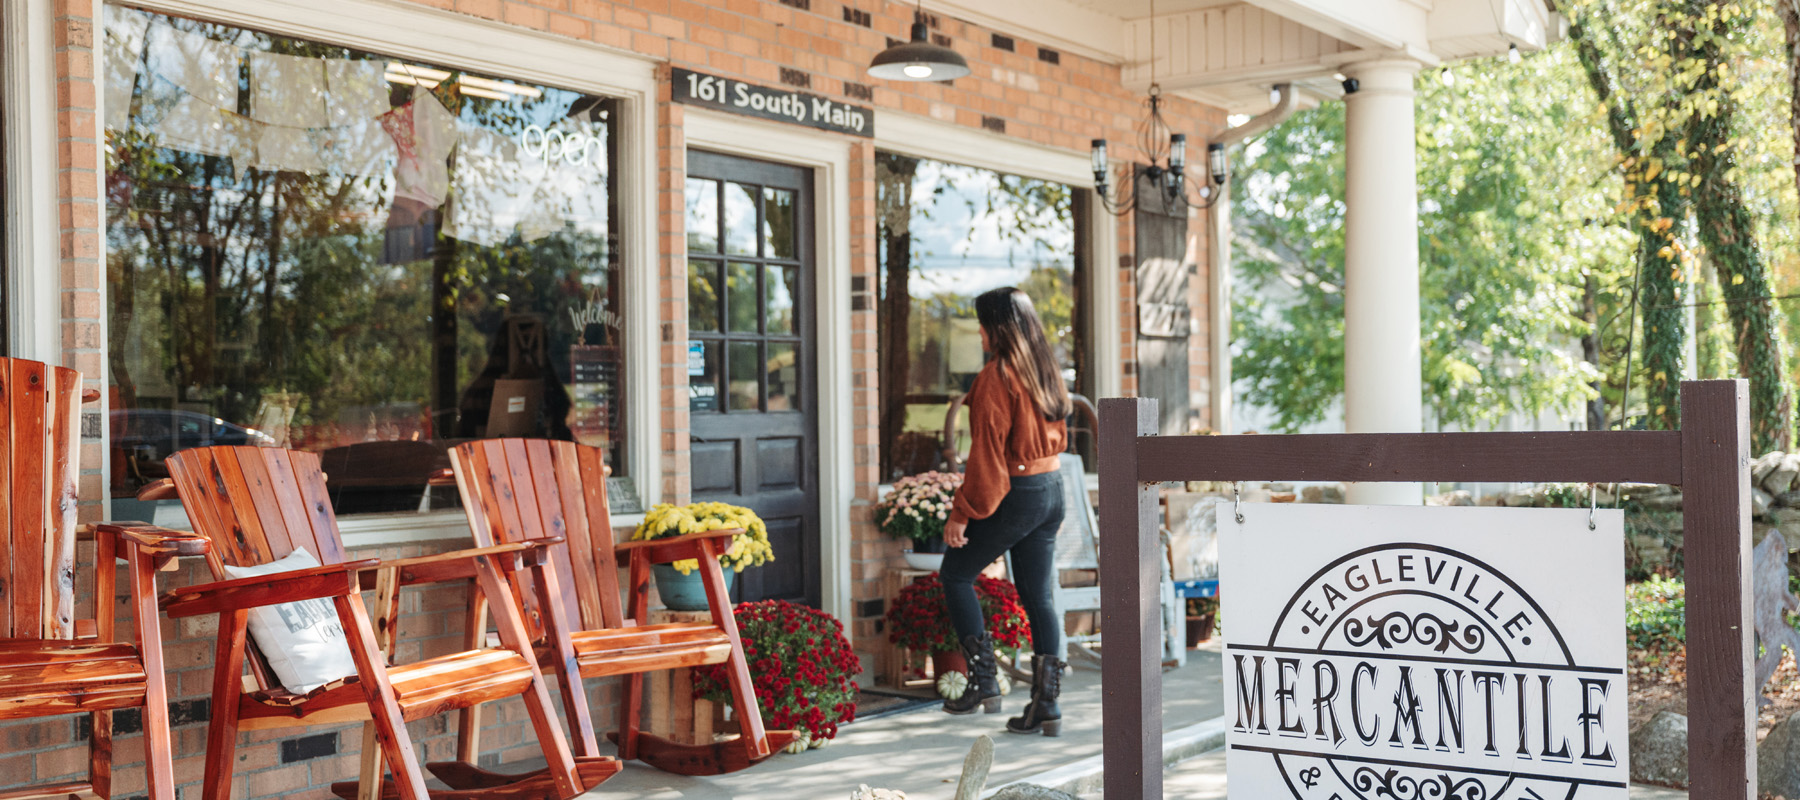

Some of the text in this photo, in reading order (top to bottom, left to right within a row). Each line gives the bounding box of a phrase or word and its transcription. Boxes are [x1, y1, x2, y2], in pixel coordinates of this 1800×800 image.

[687, 73, 865, 132] 161 South Main
[522, 124, 606, 171] open
[568, 300, 623, 332] Welcome
[1301, 555, 1532, 639] EAGLEVILLE
[1232, 654, 1618, 768] MERCANTILE
